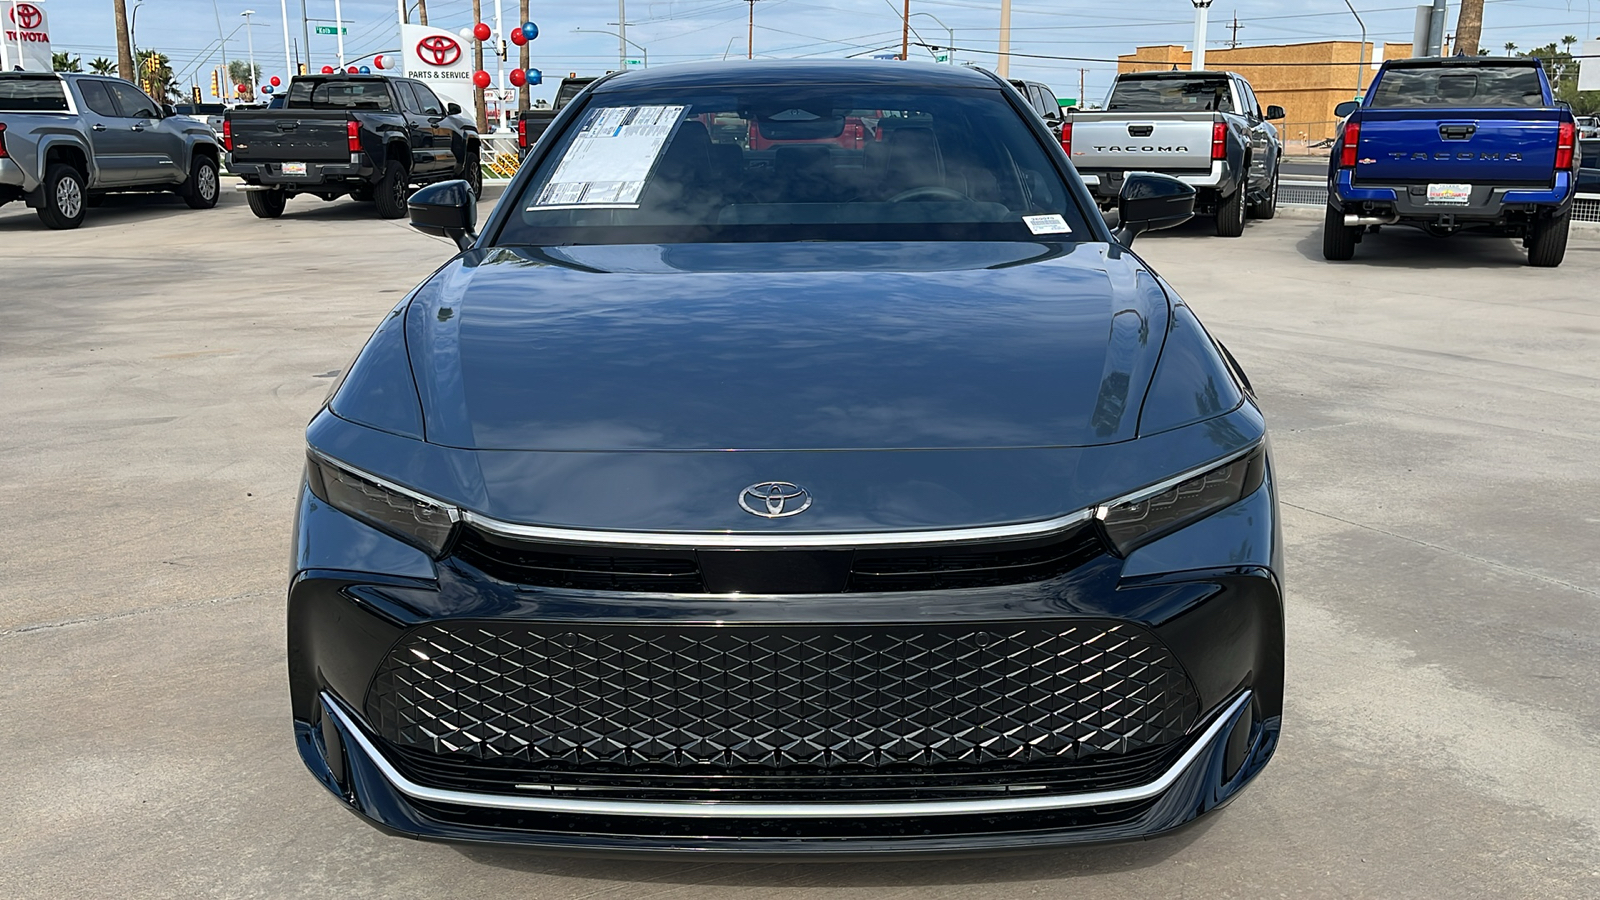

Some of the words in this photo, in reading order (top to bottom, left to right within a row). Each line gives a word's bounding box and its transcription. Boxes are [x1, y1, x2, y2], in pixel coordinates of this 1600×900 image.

[5, 31, 50, 43] TOYOTA
[408, 70, 433, 79] PARTS
[433, 71, 440, 79] &
[440, 71, 470, 79] SERVICE
[1388, 152, 1523, 161] TACOMA
